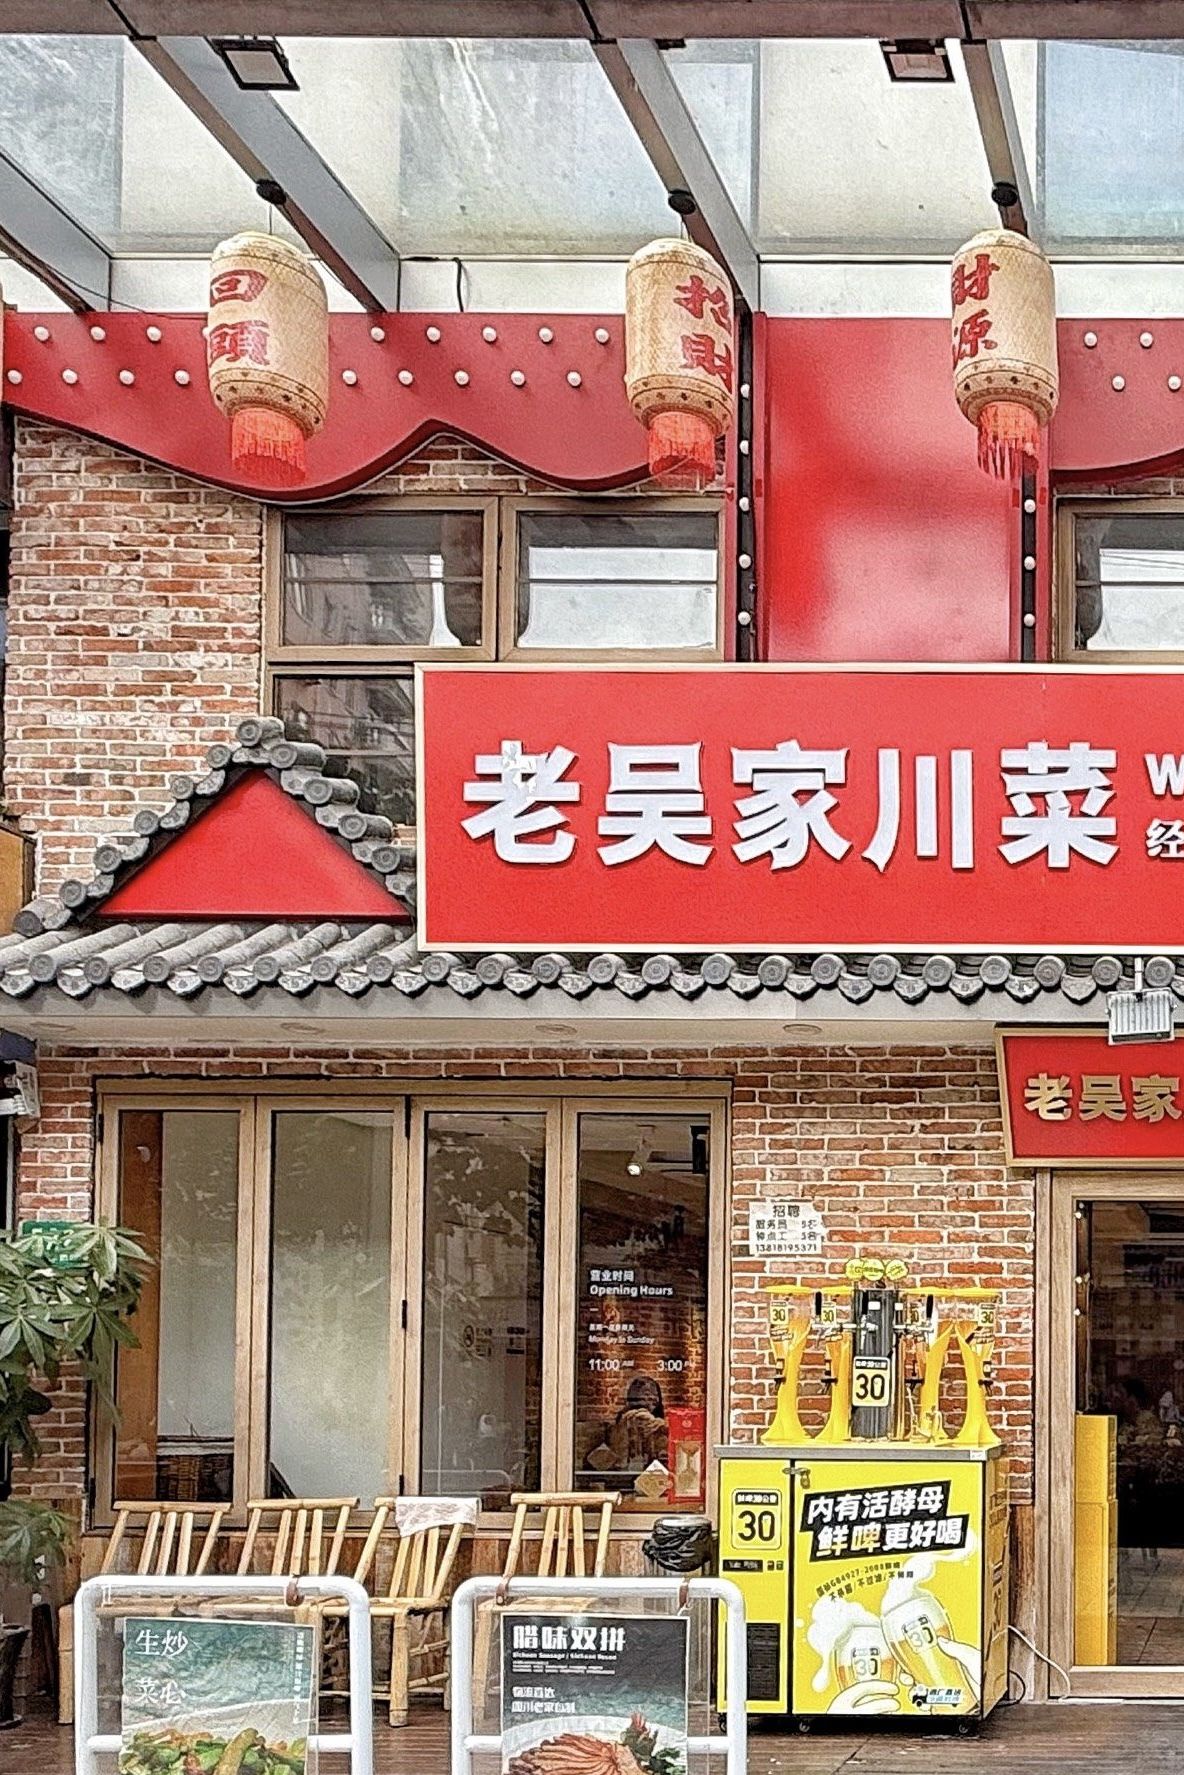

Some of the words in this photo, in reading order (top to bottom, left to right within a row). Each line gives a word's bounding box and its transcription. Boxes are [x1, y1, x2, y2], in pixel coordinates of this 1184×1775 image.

[461, 740, 1119, 872] 老吴家川菜
[772, 1204, 801, 1218] 招聘
[590, 1269, 635, 1282] 营业时间
[590, 1285, 639, 1297] Opening
[640, 1285, 674, 1296] Hours
[772, 1308, 786, 1322] 30
[822, 1309, 835, 1322] 30
[980, 1311, 994, 1324] 30
[627, 1336, 656, 1345] Sunday
[588, 1359, 620, 1371] 11:00
[855, 1373, 886, 1401] 30
[806, 1485, 945, 1525] 内有活酵母
[737, 1510, 776, 1542] 30
[816, 1517, 964, 1557] 鲜啤更好喝
[133, 1629, 189, 1660] 生炒
[512, 1625, 627, 1652] 腊味双拼
